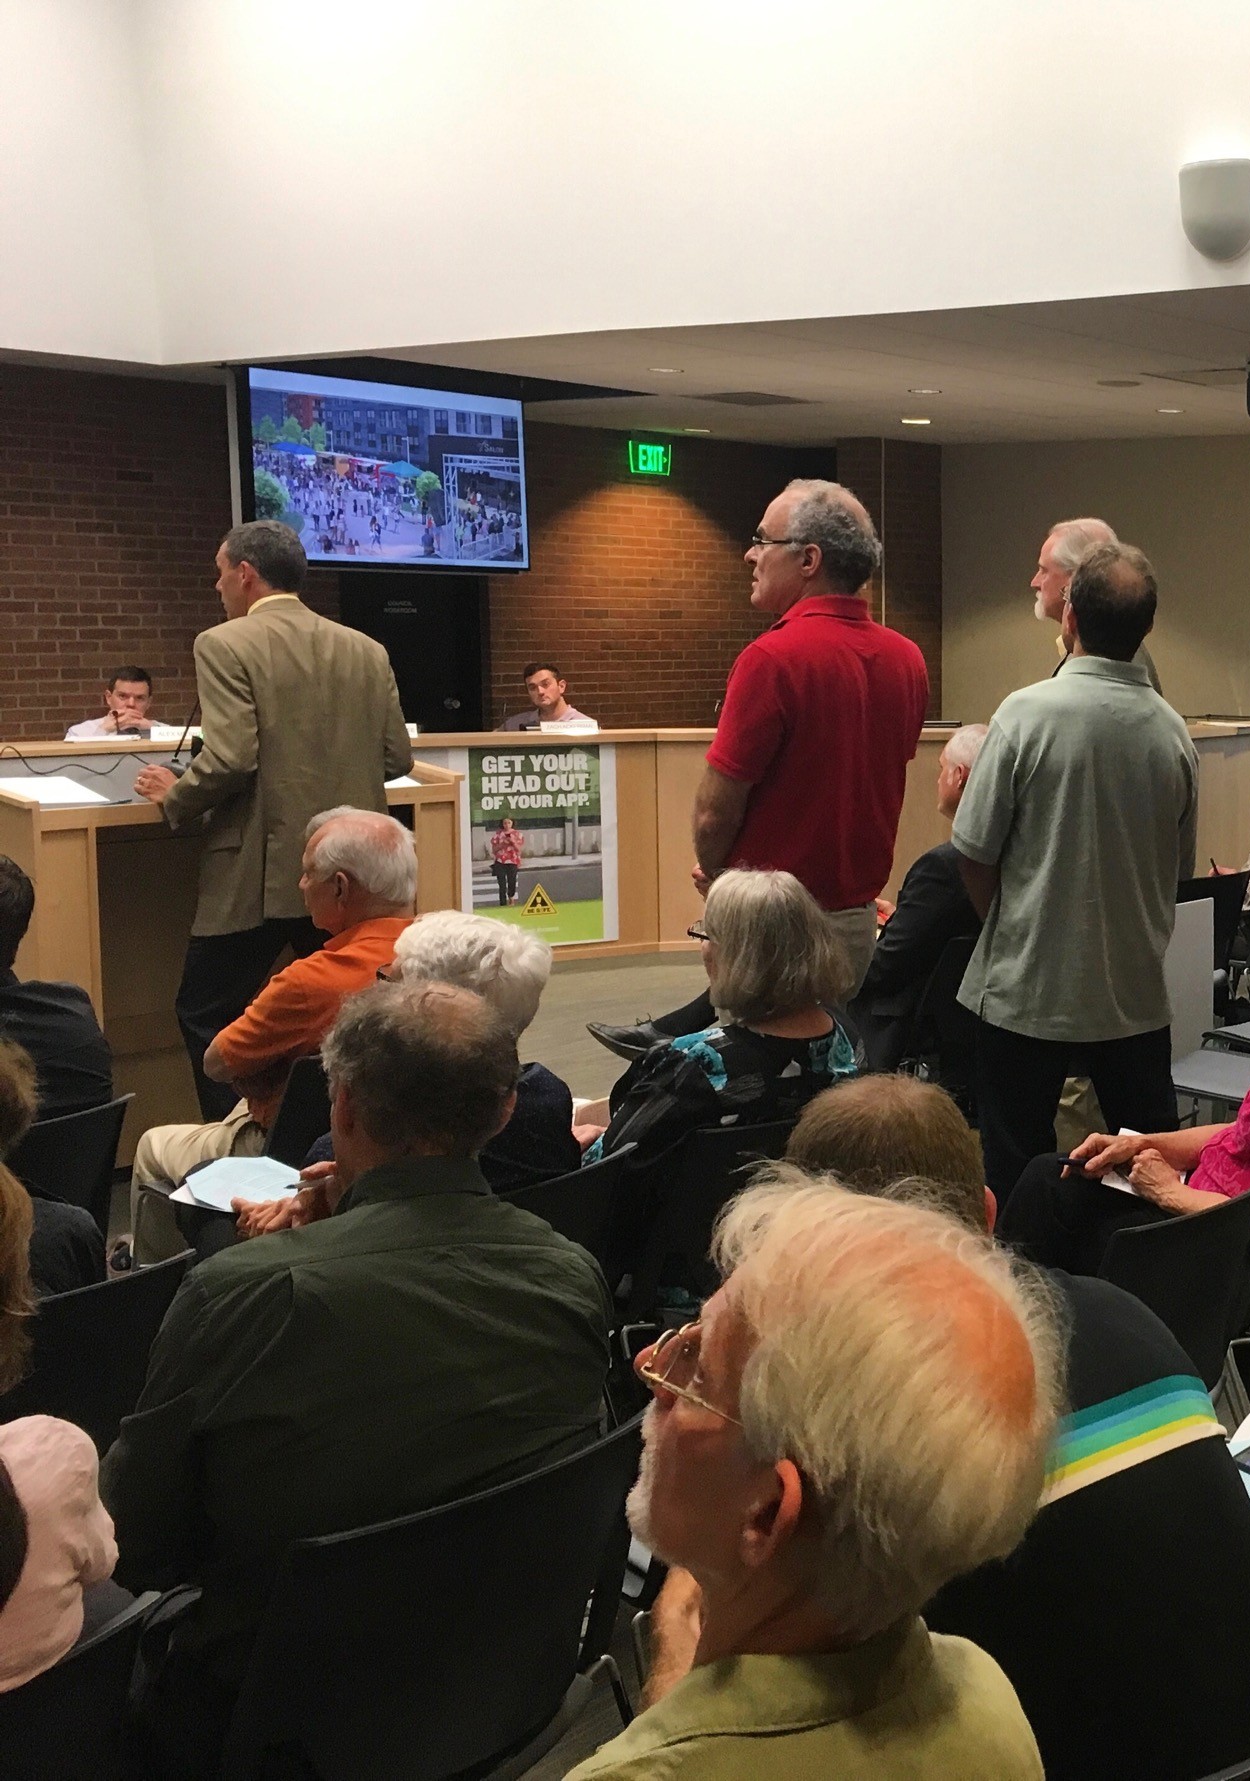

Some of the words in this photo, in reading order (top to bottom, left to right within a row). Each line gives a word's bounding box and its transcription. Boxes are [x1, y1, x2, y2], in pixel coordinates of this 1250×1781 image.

[638, 444, 664, 472] EXIT
[482, 755, 525, 774] GET
[529, 753, 588, 772] YOUR
[482, 775, 541, 794] HEAD
[545, 773, 589, 792] OUT
[481, 796, 504, 810] OF
[507, 794, 553, 809] YOUR
[556, 792, 589, 807] APP.
